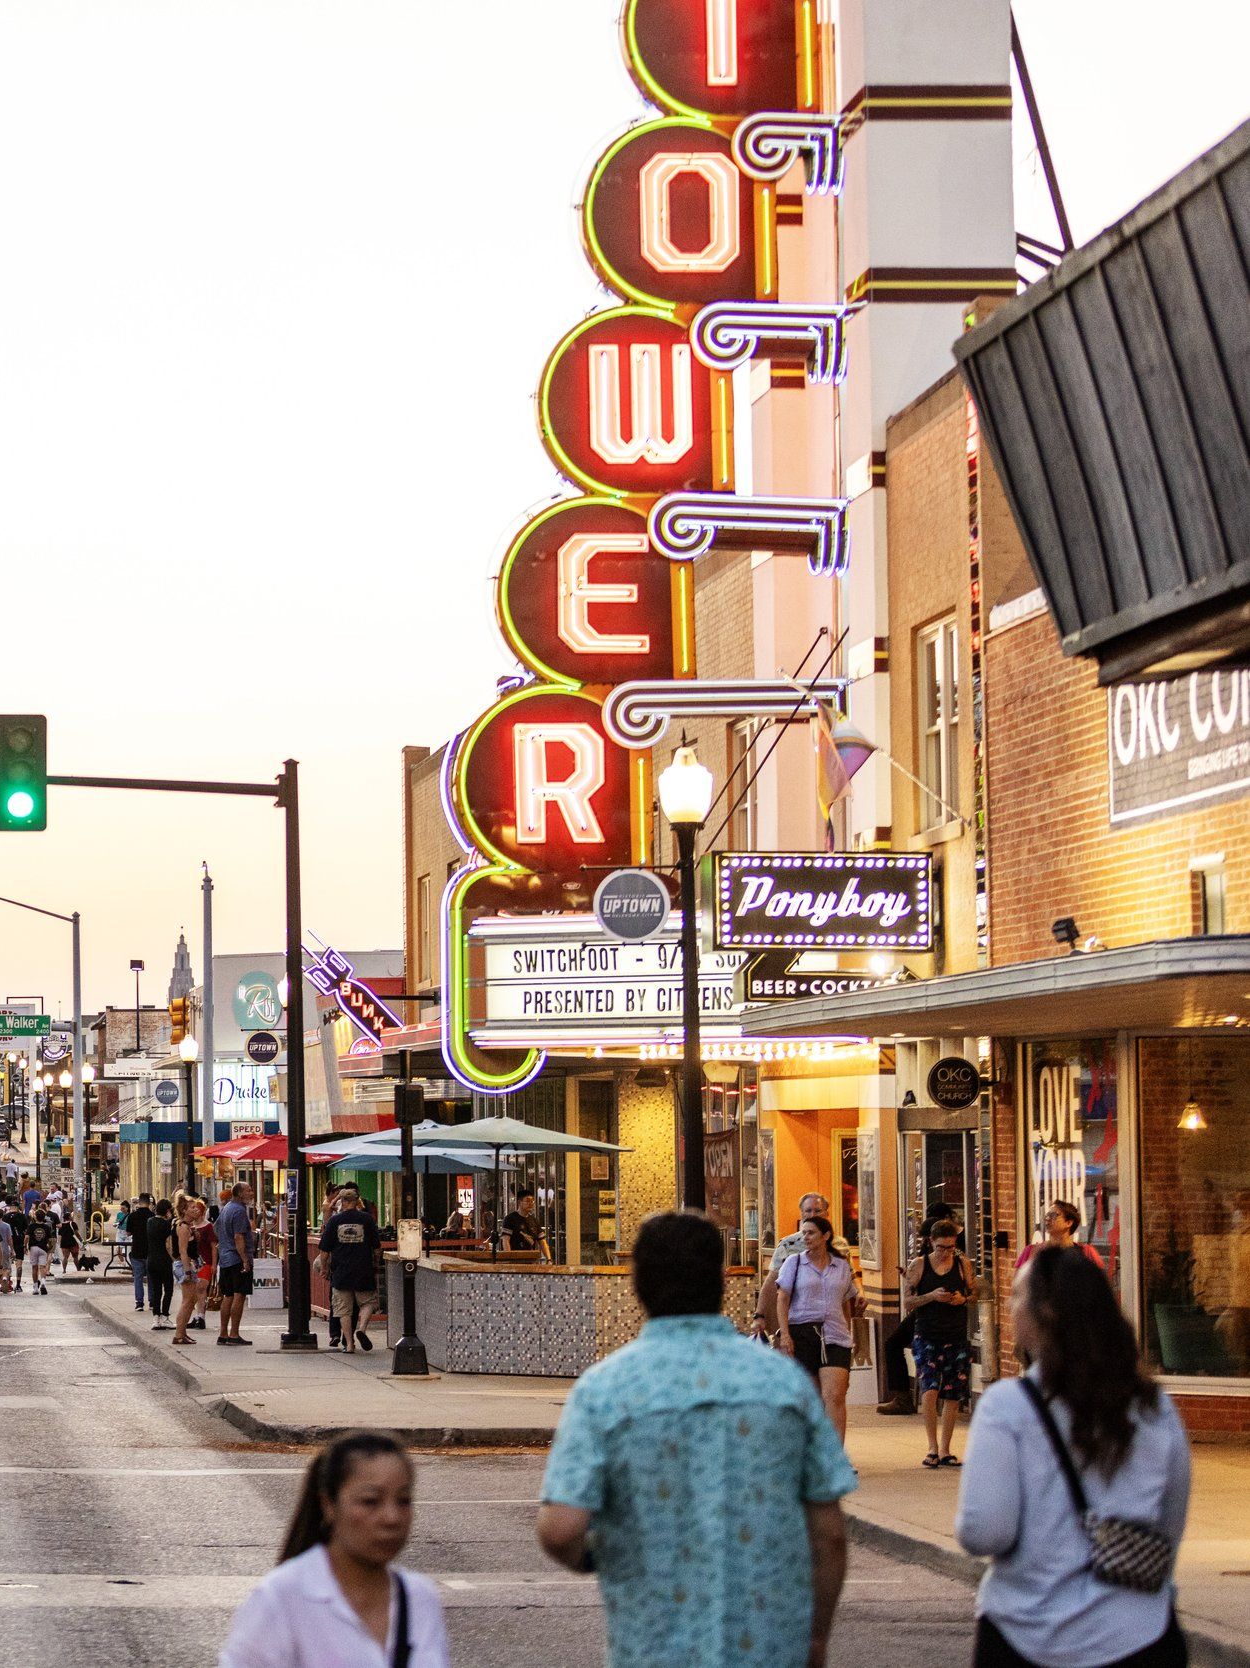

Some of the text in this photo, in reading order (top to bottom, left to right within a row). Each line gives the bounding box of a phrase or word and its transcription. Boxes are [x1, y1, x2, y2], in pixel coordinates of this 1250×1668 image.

[1114, 669, 1250, 765] OKC CO
[603, 898, 661, 914] UPTOWN
[735, 876, 912, 927] Ponyboy
[513, 947, 619, 973] SWITCHFOOT
[751, 979, 881, 995] BEER COCKT
[340, 982, 385, 1030] BUNK
[524, 986, 734, 1014] PRESENTED BY CITENS
[6, 1016, 39, 1029] Walker
[937, 1068, 971, 1081] OKC
[157, 1088, 178, 1096] UPTOWN
[937, 1092, 972, 1100] CHURCH
[1028, 1066, 1083, 1143] LOVE
[233, 1125, 261, 1133] SPEED
[1031, 1148, 1087, 1227] YOUR
